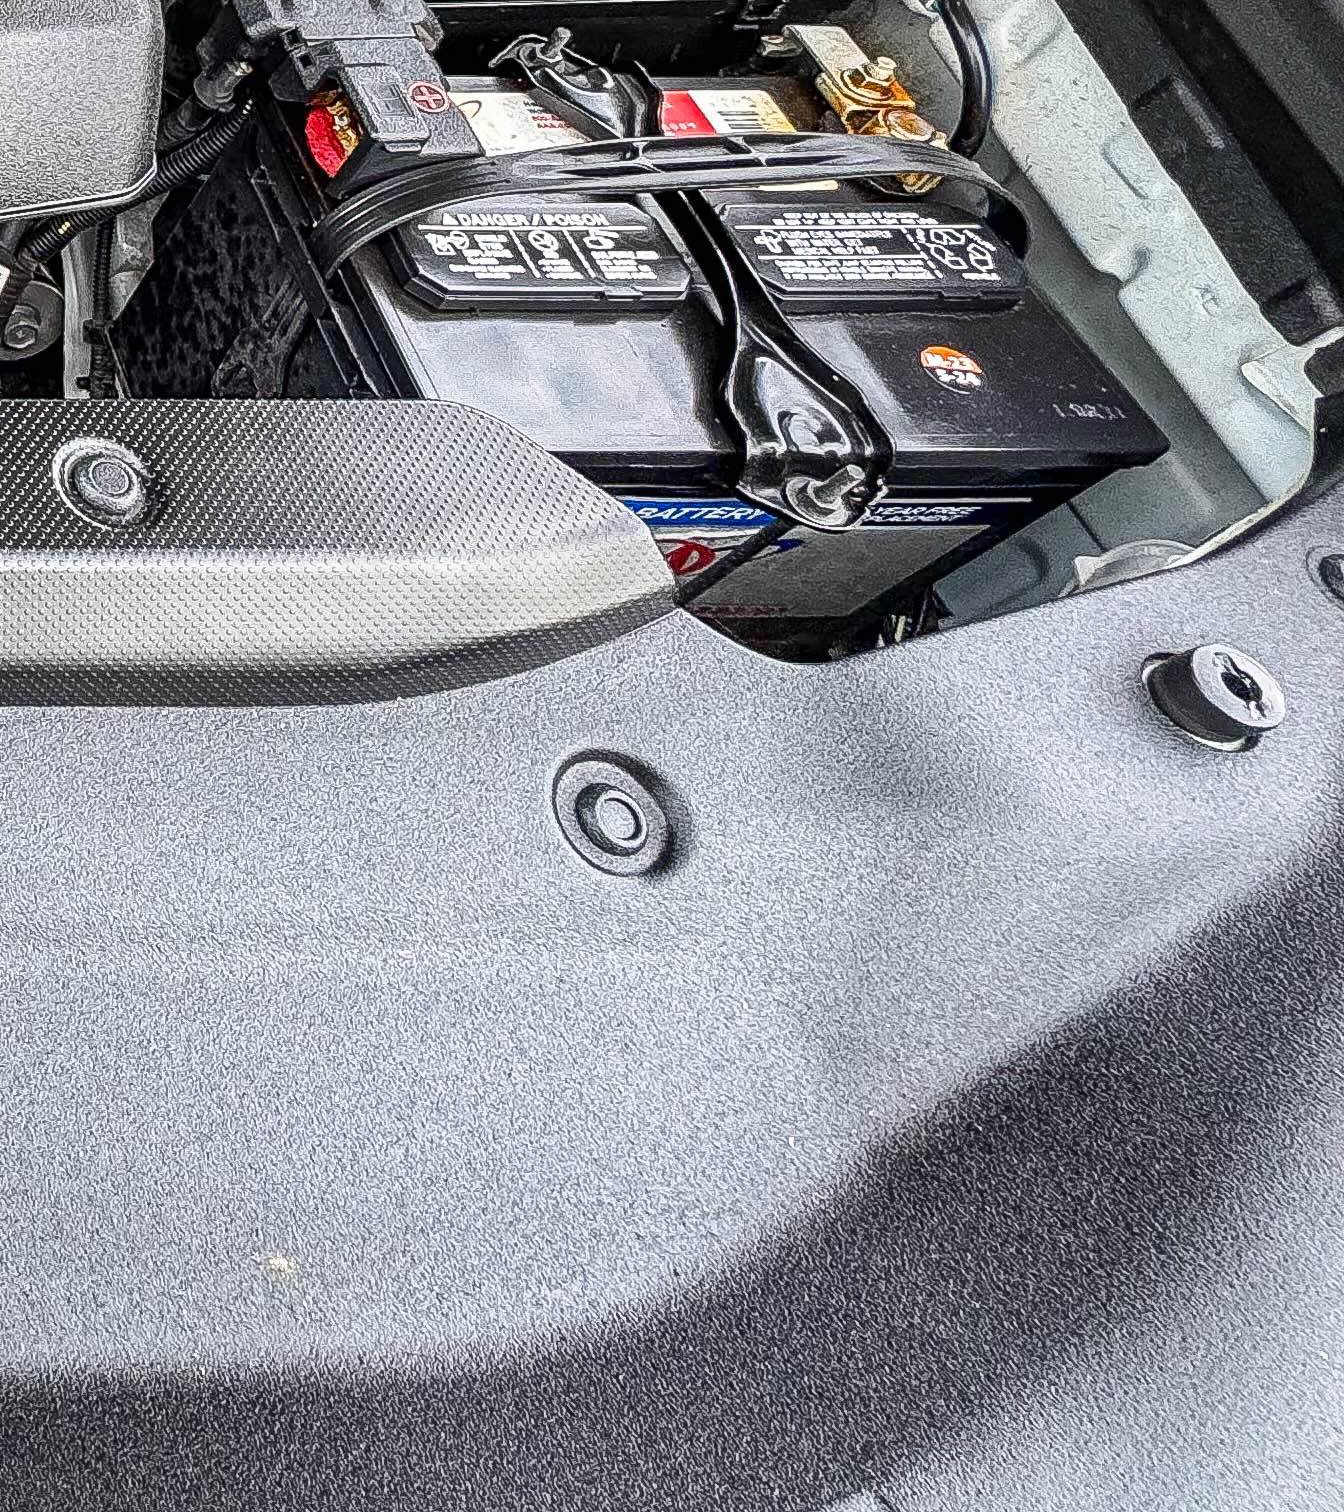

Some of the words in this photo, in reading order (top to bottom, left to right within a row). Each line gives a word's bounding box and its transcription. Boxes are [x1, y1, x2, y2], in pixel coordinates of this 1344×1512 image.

[461, 213, 530, 226] DANGER
[544, 213, 610, 226] POISON
[636, 506, 766, 520] BATTERY
[873, 506, 929, 515] YEAR
[924, 506, 983, 515] FREE
